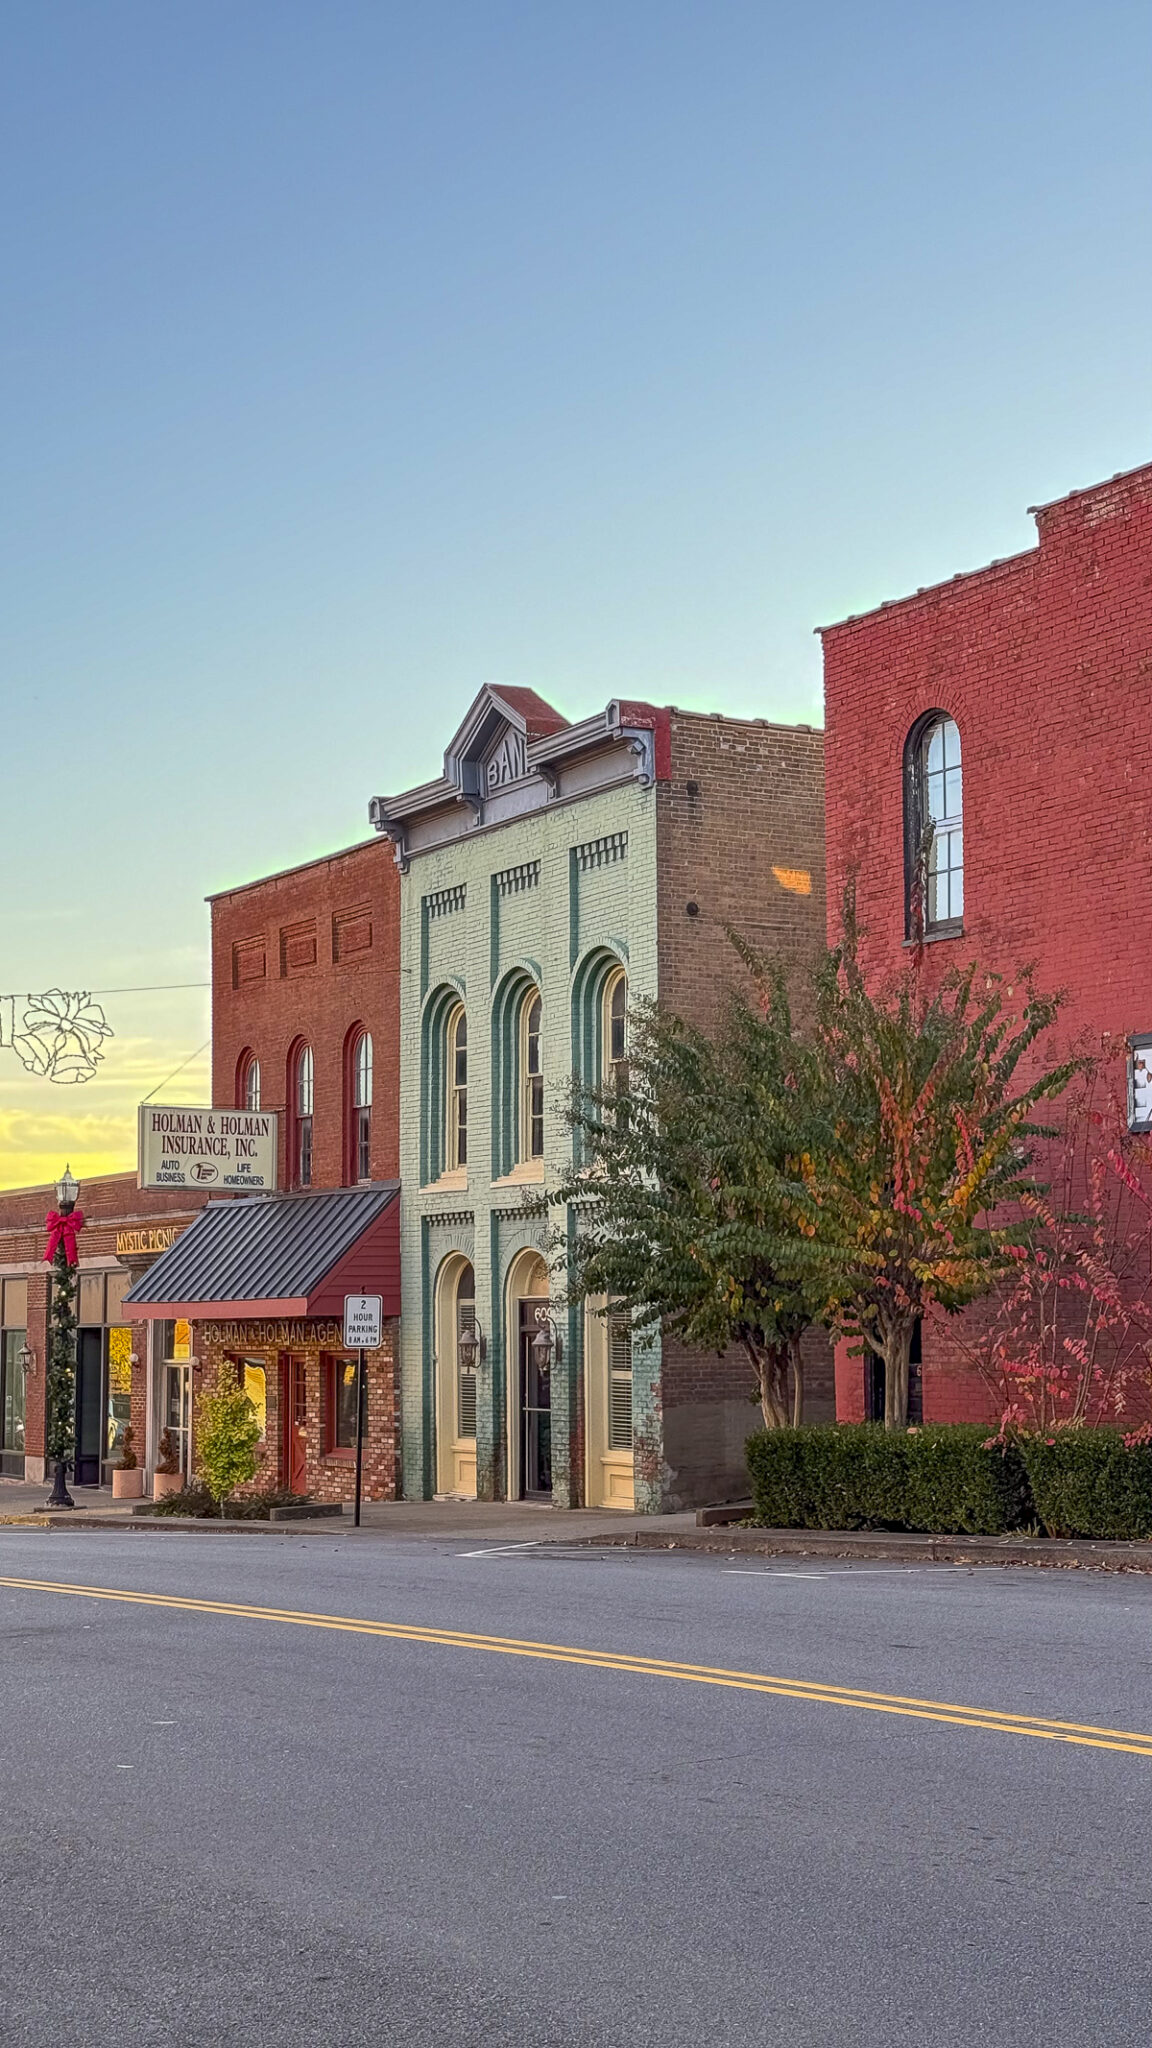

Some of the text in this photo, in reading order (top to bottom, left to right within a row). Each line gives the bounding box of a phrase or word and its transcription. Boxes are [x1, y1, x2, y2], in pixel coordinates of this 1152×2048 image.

[488, 732, 536, 788] BAN
[152, 1113, 270, 1137] HOLMAN & HOLMAN
[161, 1135, 258, 1160] INSURANCE, INC.
[161, 1160, 180, 1171] AUTO
[237, 1163, 252, 1174] LIFE
[156, 1171, 186, 1183] BUSINESS
[223, 1174, 265, 1186] HOMEOWNERS
[117, 1227, 178, 1252] MYSTIC PICNIC
[360, 1299, 367, 1310] 2
[353, 1313, 373, 1322] HOUR
[204, 1322, 247, 1342] HOLMAN
[260, 1322, 304, 1342] HOLMAN
[310, 1323, 343, 1343] AGEN
[348, 1325, 378, 1334] PARKING
[353, 1336, 361, 1344] AM
